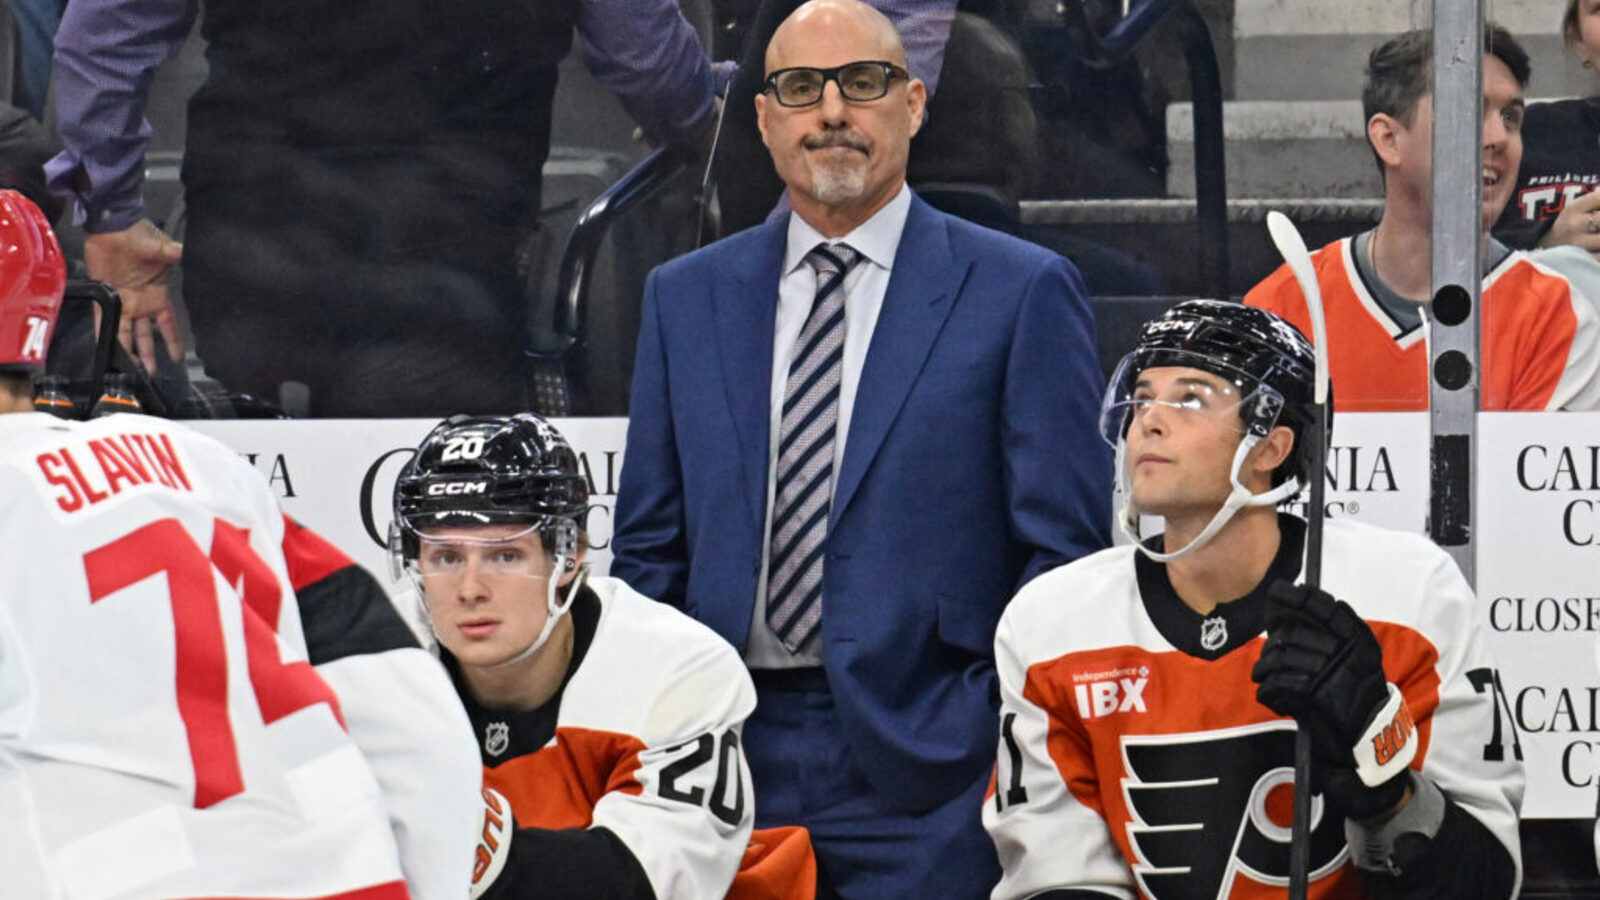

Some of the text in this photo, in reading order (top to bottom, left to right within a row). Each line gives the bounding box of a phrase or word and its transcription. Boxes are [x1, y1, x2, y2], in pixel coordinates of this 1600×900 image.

[22, 316, 48, 359] 74
[441, 436, 486, 463] 20
[36, 433, 192, 513] SLAVIN
[428, 481, 487, 496] CCM
[1074, 677, 1148, 719] IBX
[658, 728, 744, 827] 20
